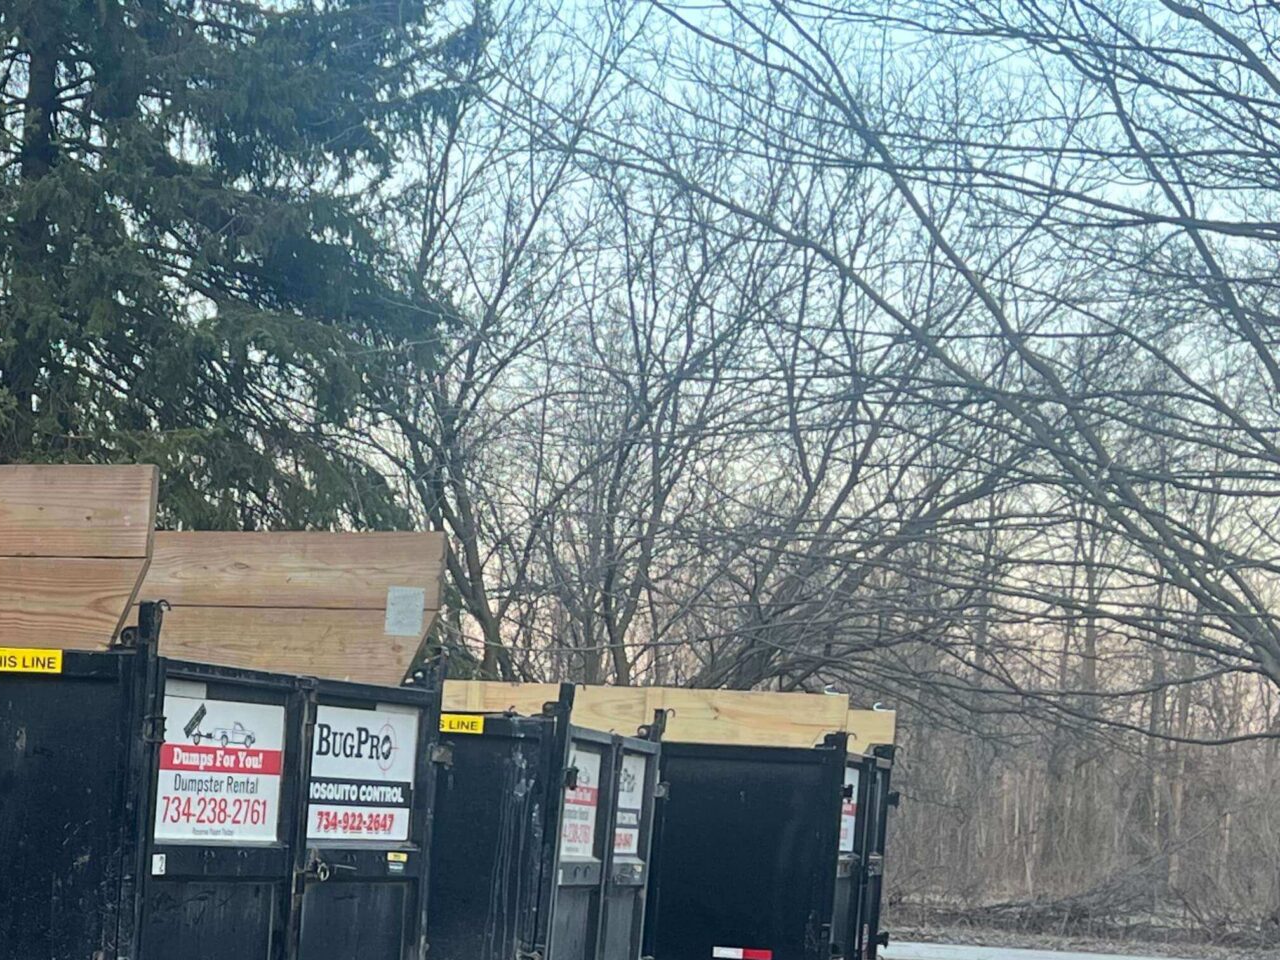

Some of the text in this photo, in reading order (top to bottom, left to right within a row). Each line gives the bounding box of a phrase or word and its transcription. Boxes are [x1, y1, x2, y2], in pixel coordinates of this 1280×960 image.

[22, 656, 57, 670] LINE
[448, 720, 478, 731] LINE
[173, 747, 263, 770] Dumps For You!
[174, 773, 259, 795] Dumpster Rental
[310, 782, 404, 803] OSQUITO CONTROL
[162, 796, 267, 824] 734-238-2761
[317, 811, 395, 833] 734-922-2647
